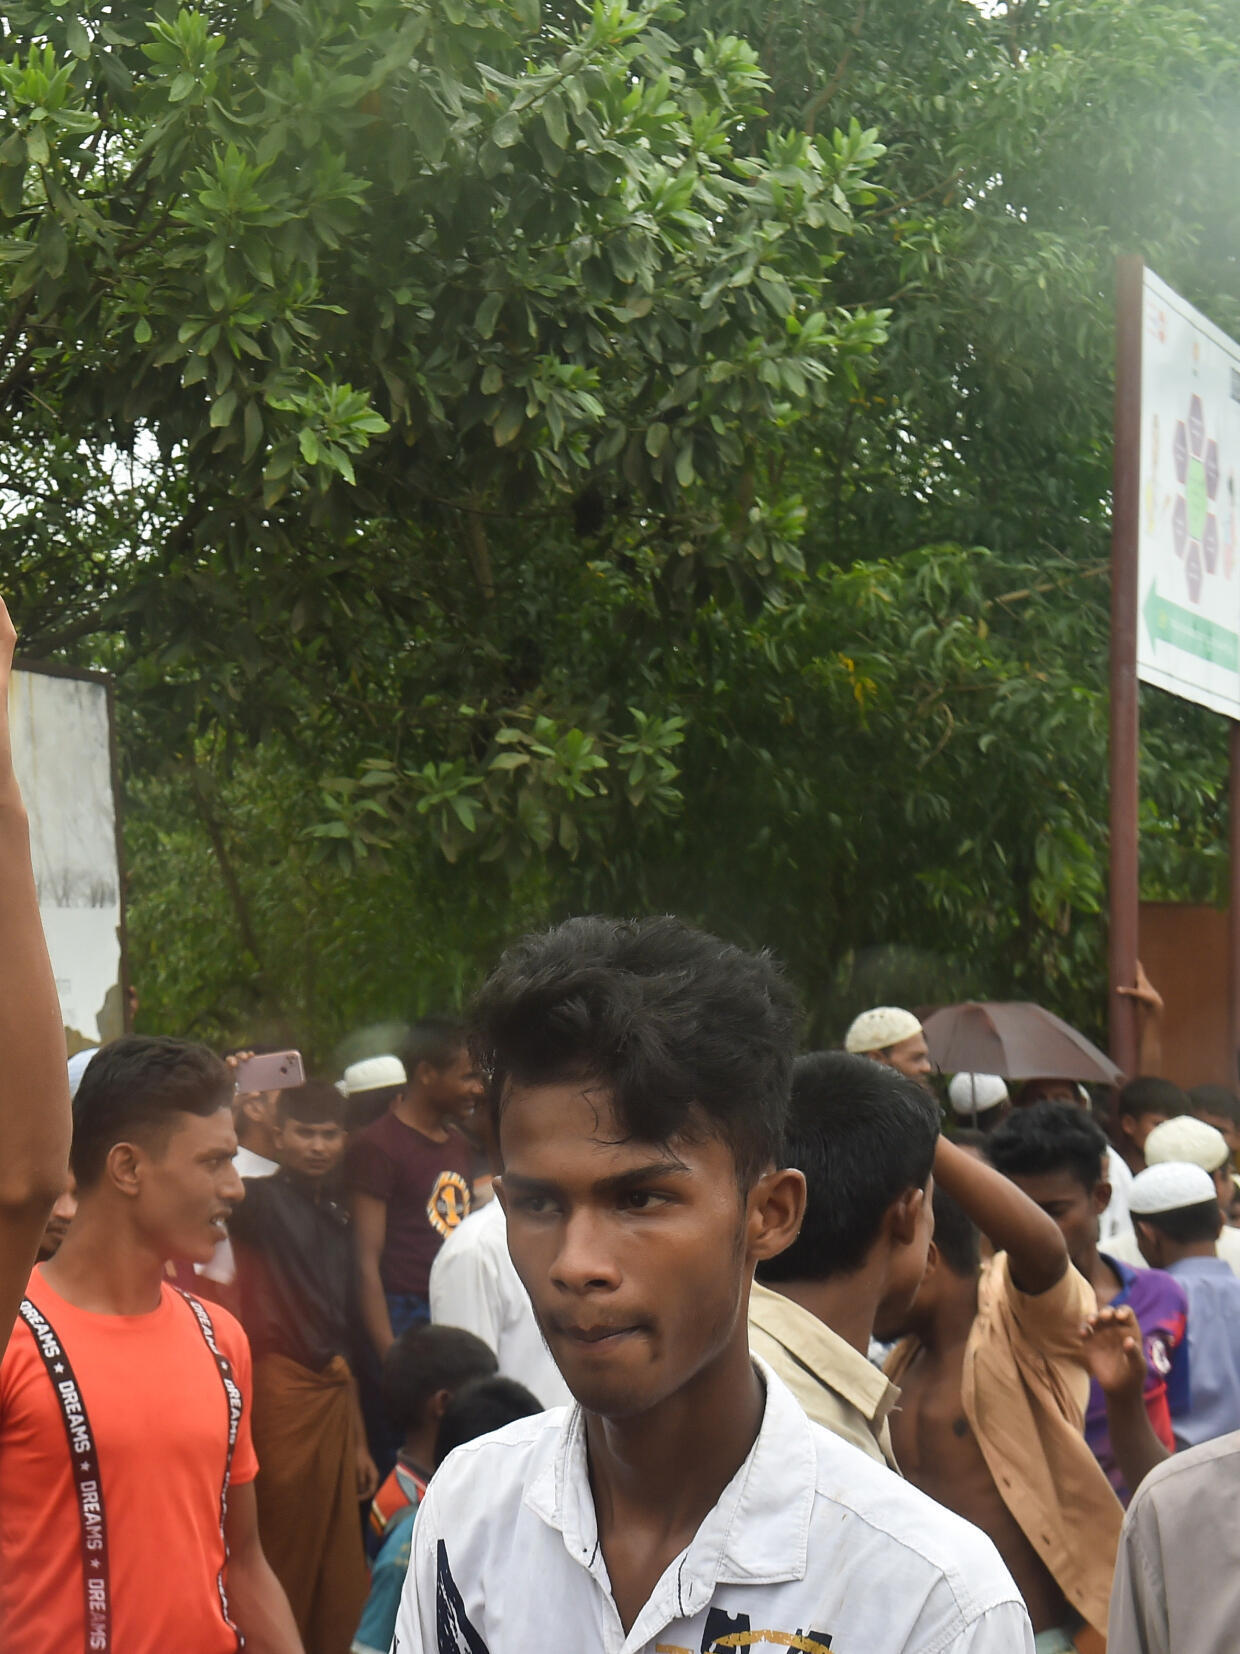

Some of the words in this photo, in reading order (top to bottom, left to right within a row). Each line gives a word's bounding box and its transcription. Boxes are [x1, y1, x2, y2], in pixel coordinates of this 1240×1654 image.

[19, 1299, 61, 1358] DREAMS
[58, 1380, 91, 1454] DREAMS
[80, 1480, 104, 1551] DREAMS
[88, 1578, 107, 1651] DREAMS
